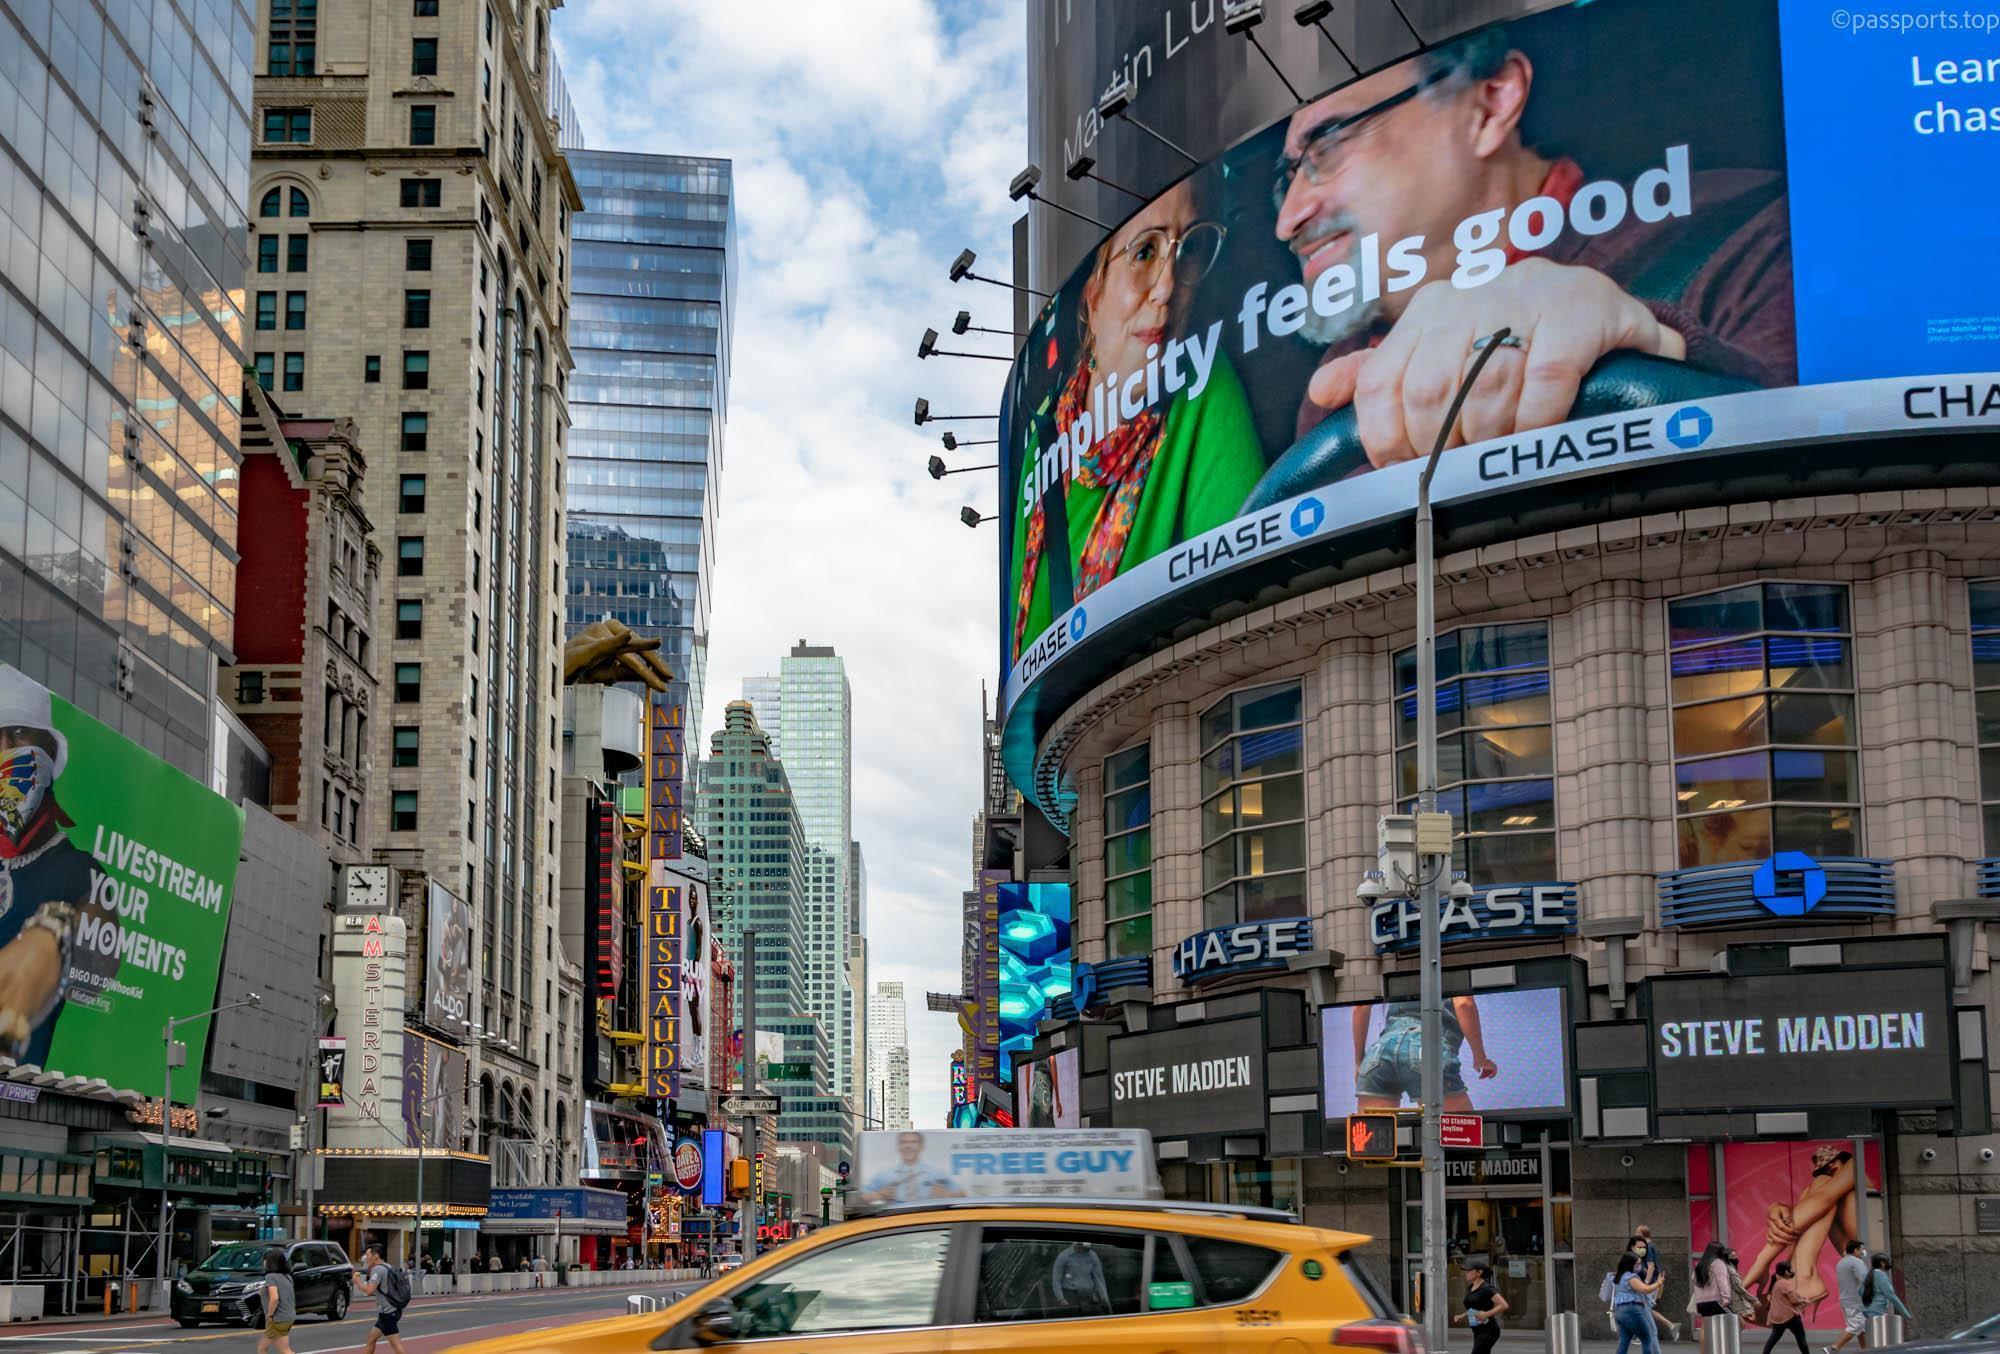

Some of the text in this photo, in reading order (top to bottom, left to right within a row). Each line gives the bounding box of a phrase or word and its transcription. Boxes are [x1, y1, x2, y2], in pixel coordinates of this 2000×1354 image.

[1022, 144, 1692, 518] simplicity feels good
[1479, 419, 1654, 482] CHASE
[1168, 512, 1282, 583] CHASE
[1022, 621, 1068, 684] CHASE
[653, 704, 680, 858] MADAME
[92, 824, 223, 914] LIVESTREAM
[89, 868, 149, 924] YOUR
[1371, 886, 1570, 945] CHASE
[346, 917, 362, 926] NEW
[76, 911, 187, 981] MOMENTS
[69, 967, 90, 983] BIGO
[359, 916, 384, 1119] AMSTERDAM
[433, 990, 464, 1017] ALDO
[1661, 1012, 1926, 1057] STEVE MADDEN
[8, 1086, 37, 1099] PRIME
[779, 1065, 785, 1077] 7
[1114, 1056, 1251, 1101] STEVE MADDEN
[1442, 1117, 1450, 1125] NO
[676, 1152, 694, 1168] DAVE
[952, 1149, 1134, 1176] FREE GUY
[1444, 1158, 1538, 1177] TEVE MADDEN
